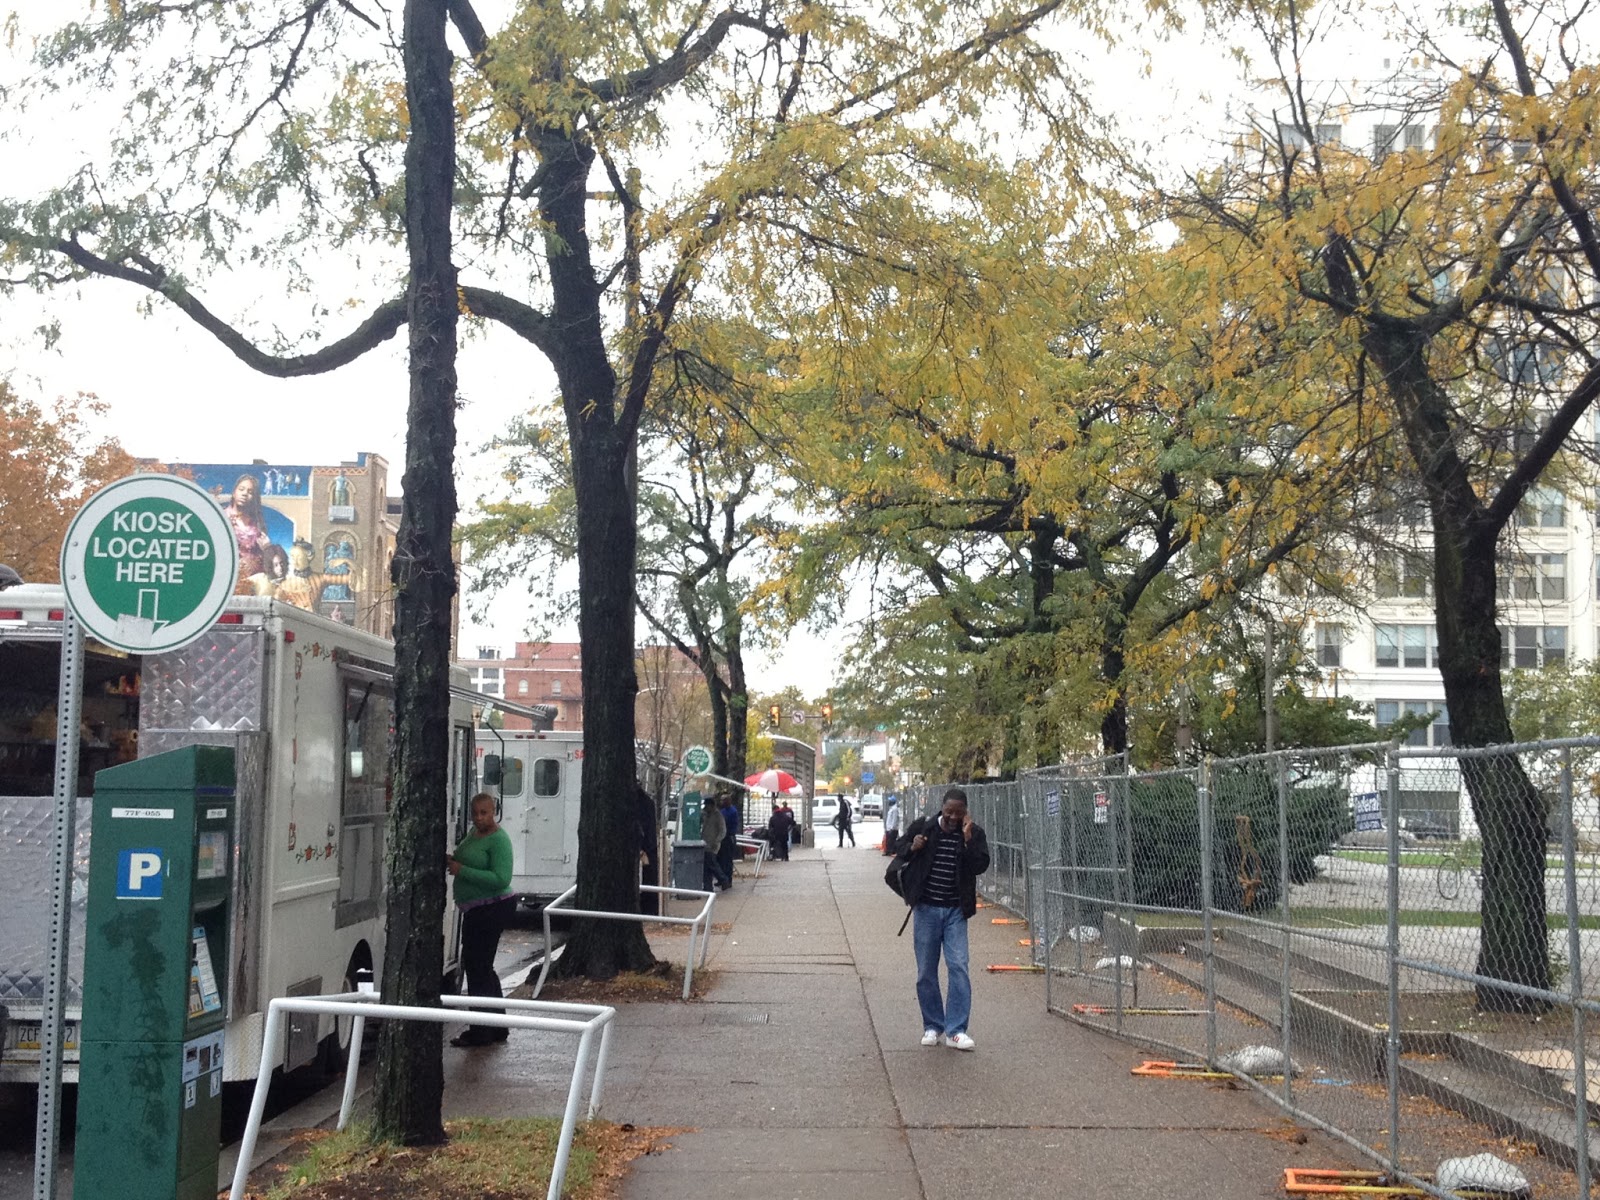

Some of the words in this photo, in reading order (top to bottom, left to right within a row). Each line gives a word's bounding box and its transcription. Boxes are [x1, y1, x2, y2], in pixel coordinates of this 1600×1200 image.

[113, 512, 193, 533] KIOSK
[93, 537, 210, 560] LOCATED
[116, 562, 184, 584] HERE
[129, 853, 161, 890] P
